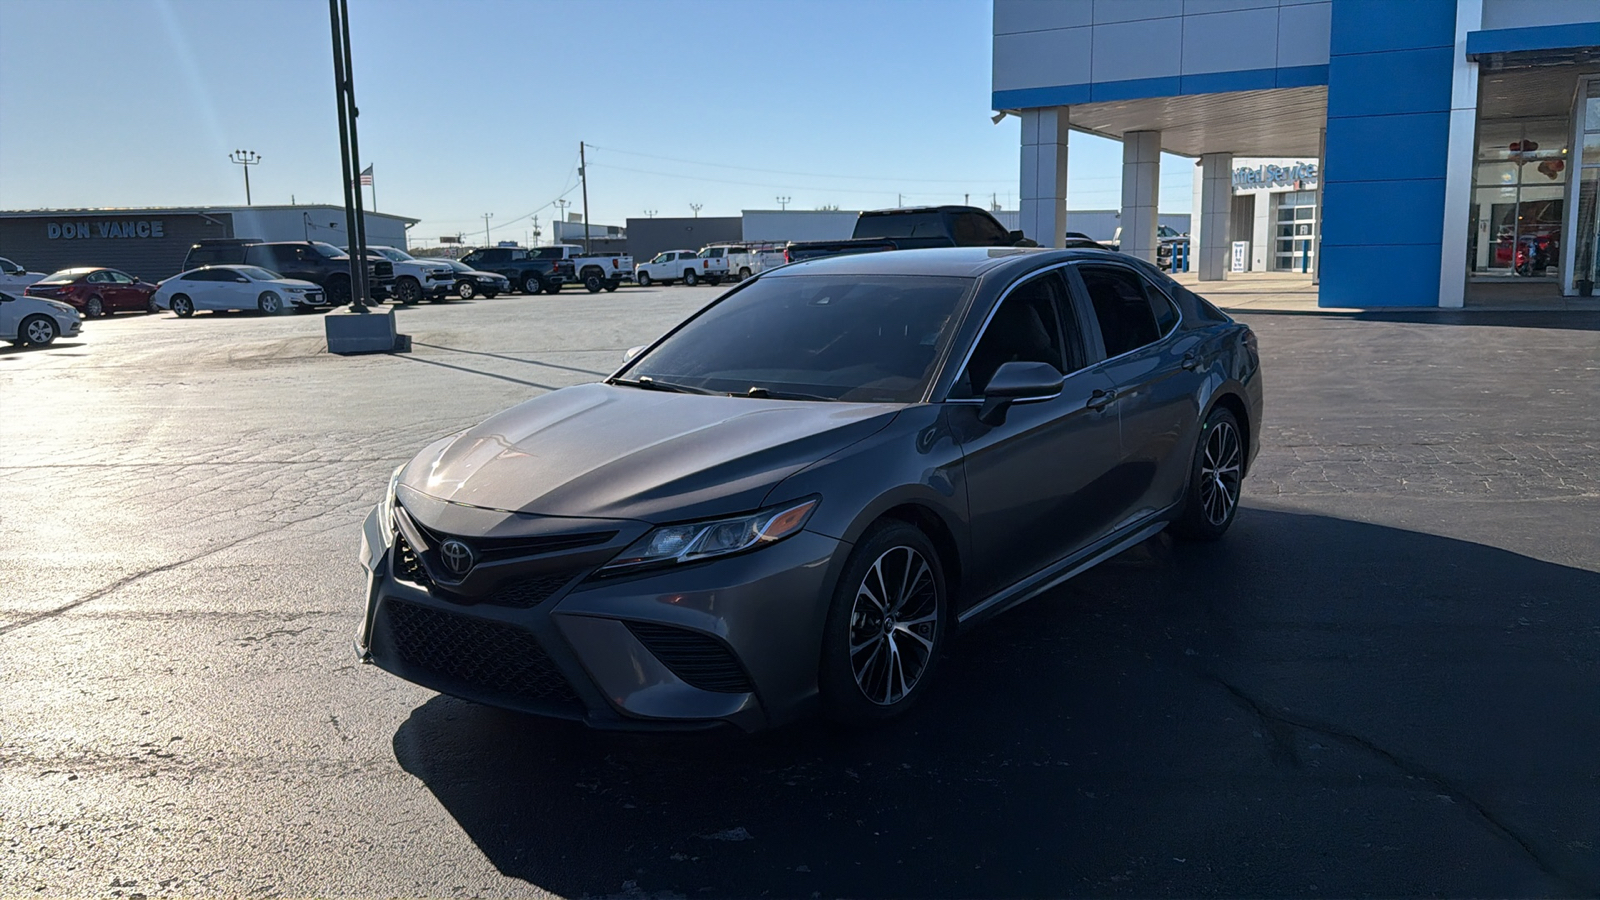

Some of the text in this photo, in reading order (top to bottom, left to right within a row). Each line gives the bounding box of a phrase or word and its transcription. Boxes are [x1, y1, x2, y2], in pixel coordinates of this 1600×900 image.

[1266, 161, 1318, 181] Service
[47, 221, 164, 239] DON VANCE
